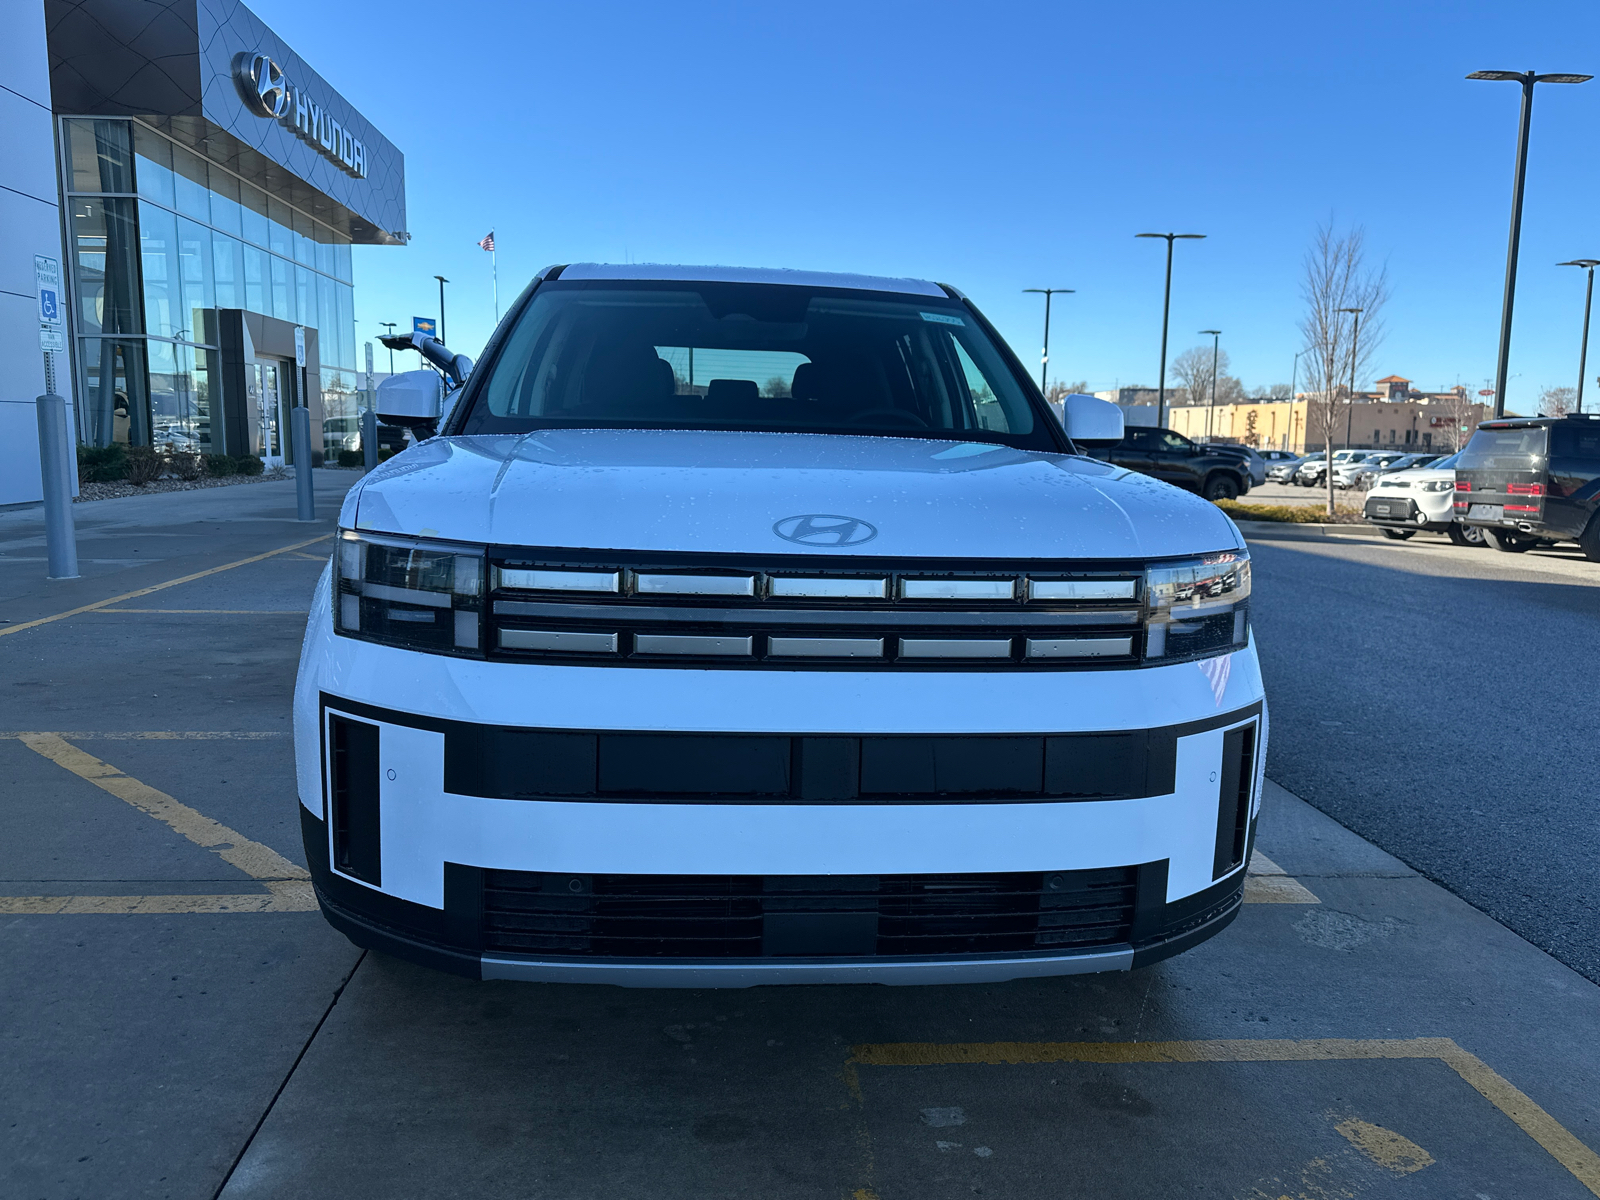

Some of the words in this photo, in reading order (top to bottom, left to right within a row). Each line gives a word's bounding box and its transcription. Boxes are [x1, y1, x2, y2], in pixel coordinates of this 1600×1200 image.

[294, 87, 368, 179] HYUNDAI
[36, 260, 56, 273] RESERVED
[37, 272, 57, 285] PARKING
